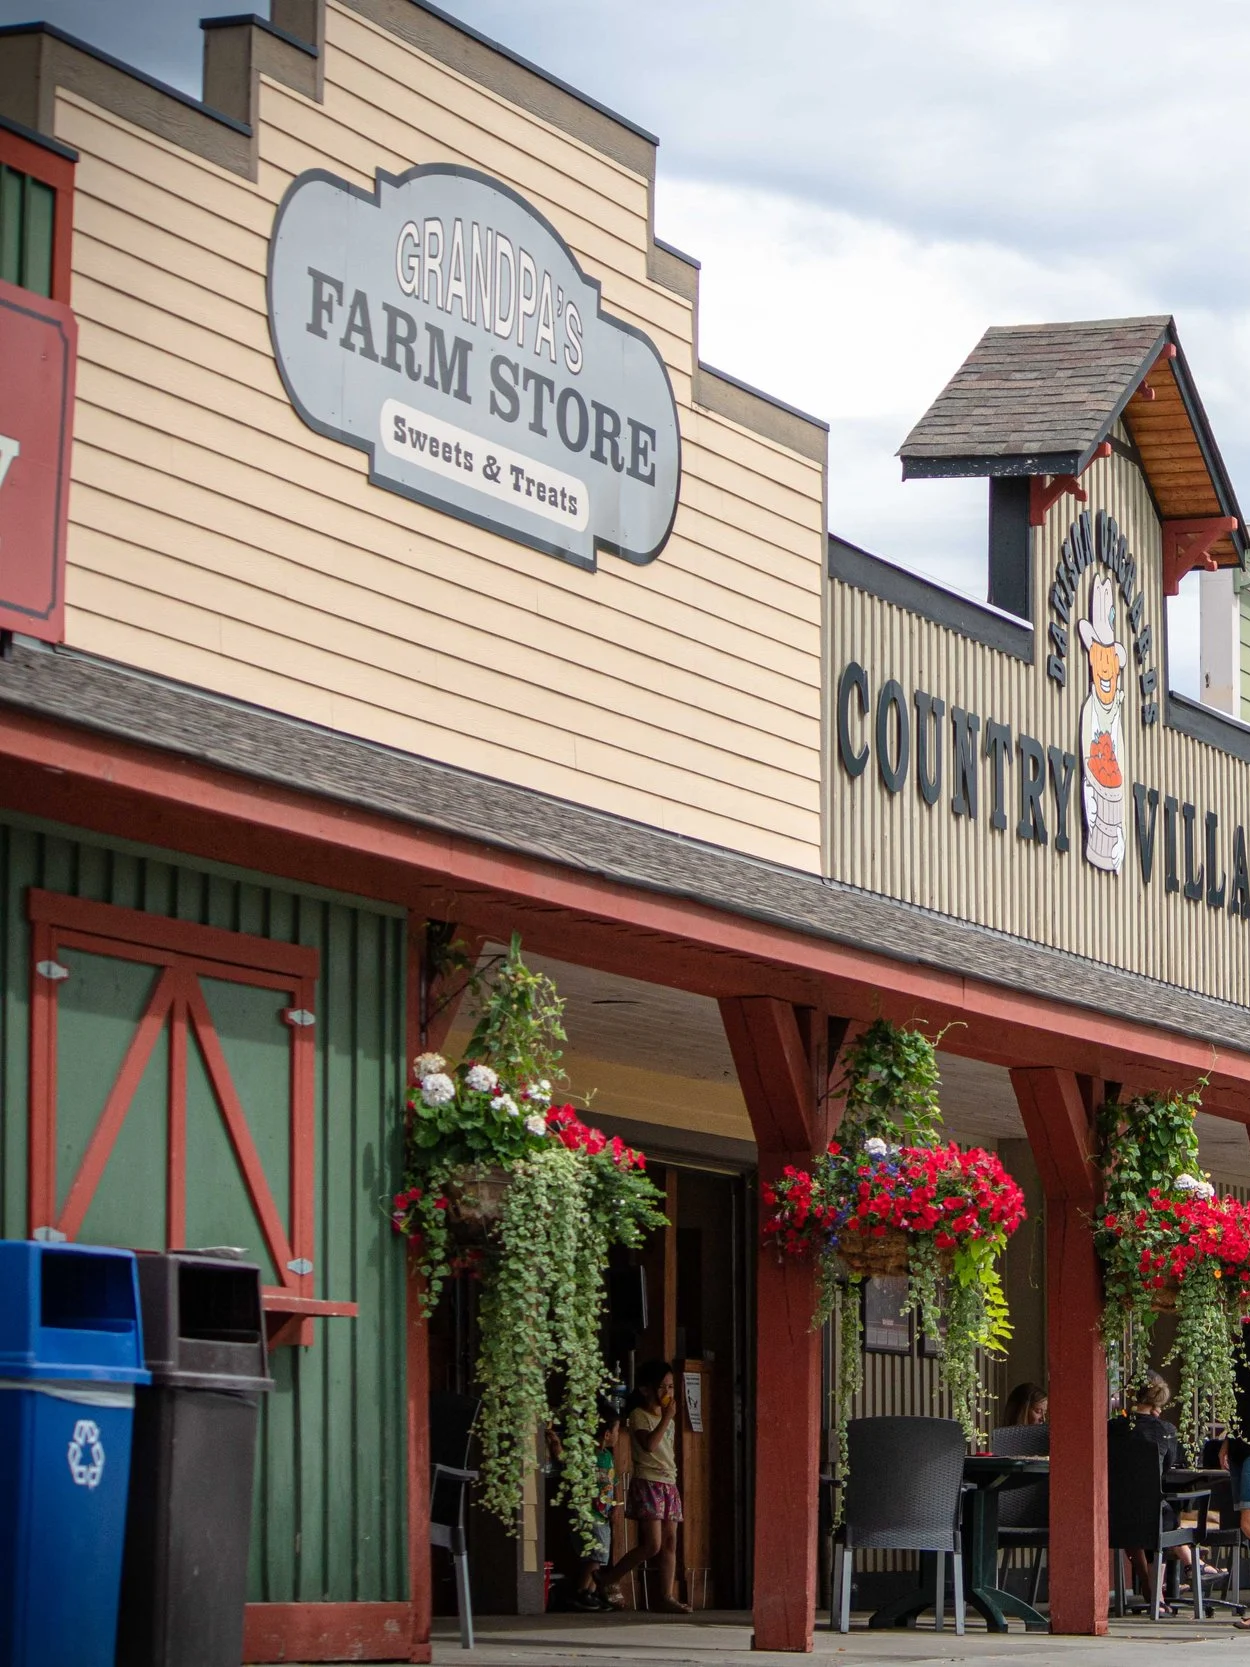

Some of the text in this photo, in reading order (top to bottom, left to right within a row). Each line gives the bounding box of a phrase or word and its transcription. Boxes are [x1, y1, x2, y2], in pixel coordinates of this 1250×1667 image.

[305, 266, 657, 487] FARM STORE
[395, 216, 584, 375] GRANDPA'S
[393, 414, 579, 516] Sweets & Treats
[1046, 508, 1160, 726] DAVISON ORCHARDS
[837, 661, 1077, 853] COUNTRY
